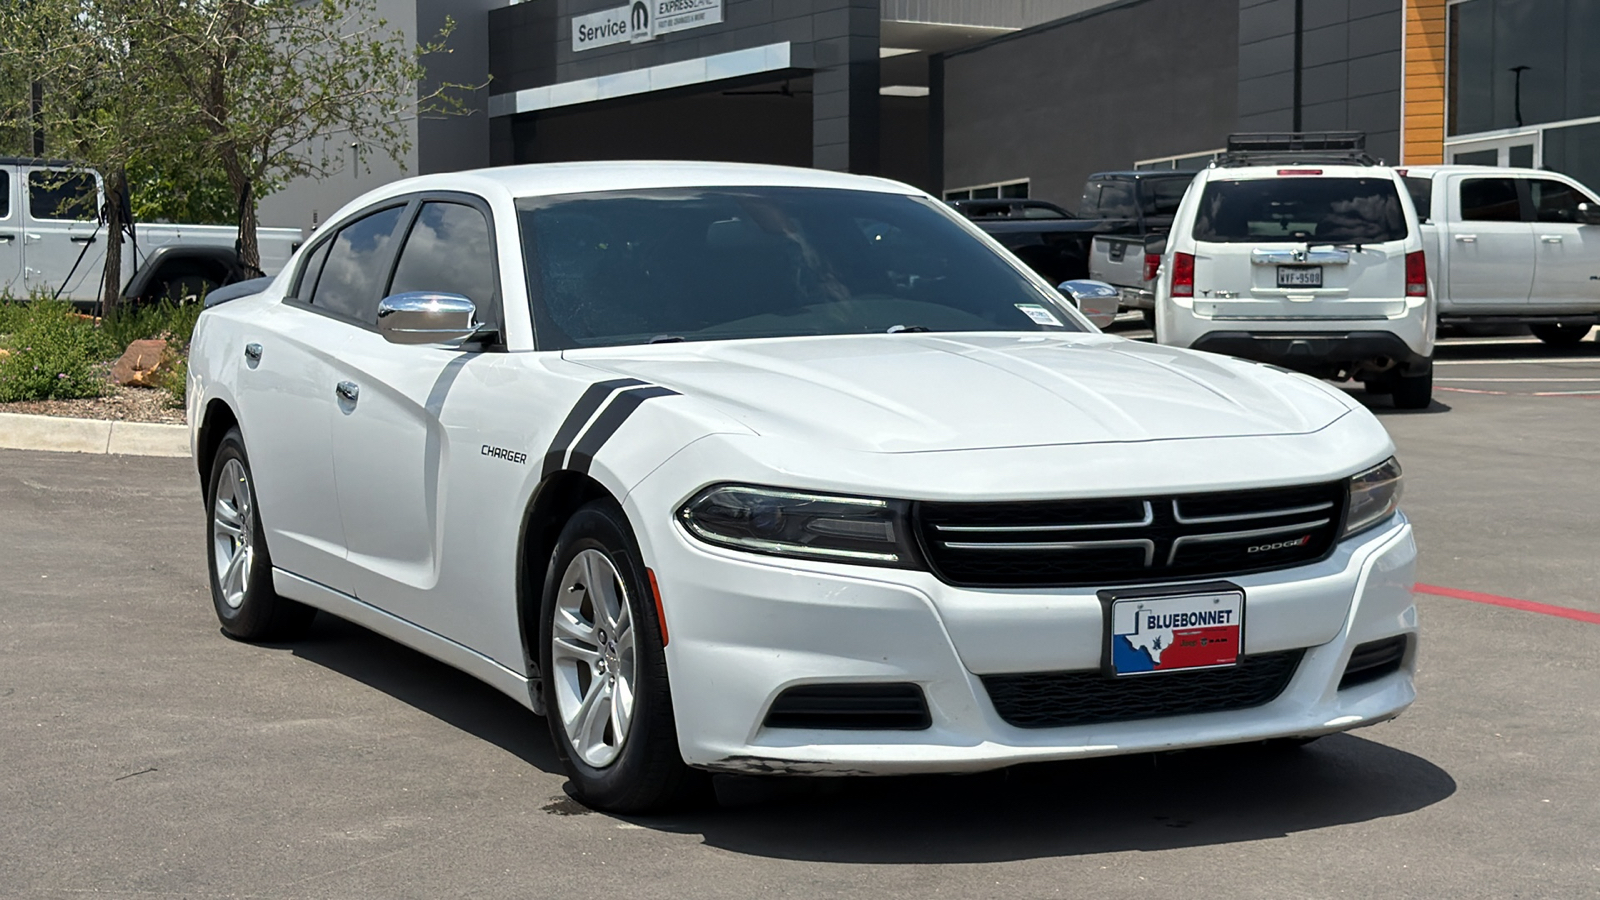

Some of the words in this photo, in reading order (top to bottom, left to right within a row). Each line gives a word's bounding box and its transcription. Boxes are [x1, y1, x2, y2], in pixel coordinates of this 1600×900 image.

[579, 19, 626, 42] Service
[481, 445, 527, 465] CHARGER
[1247, 538, 1304, 553] DODGE
[1148, 609, 1232, 629] BLUEBONNET
